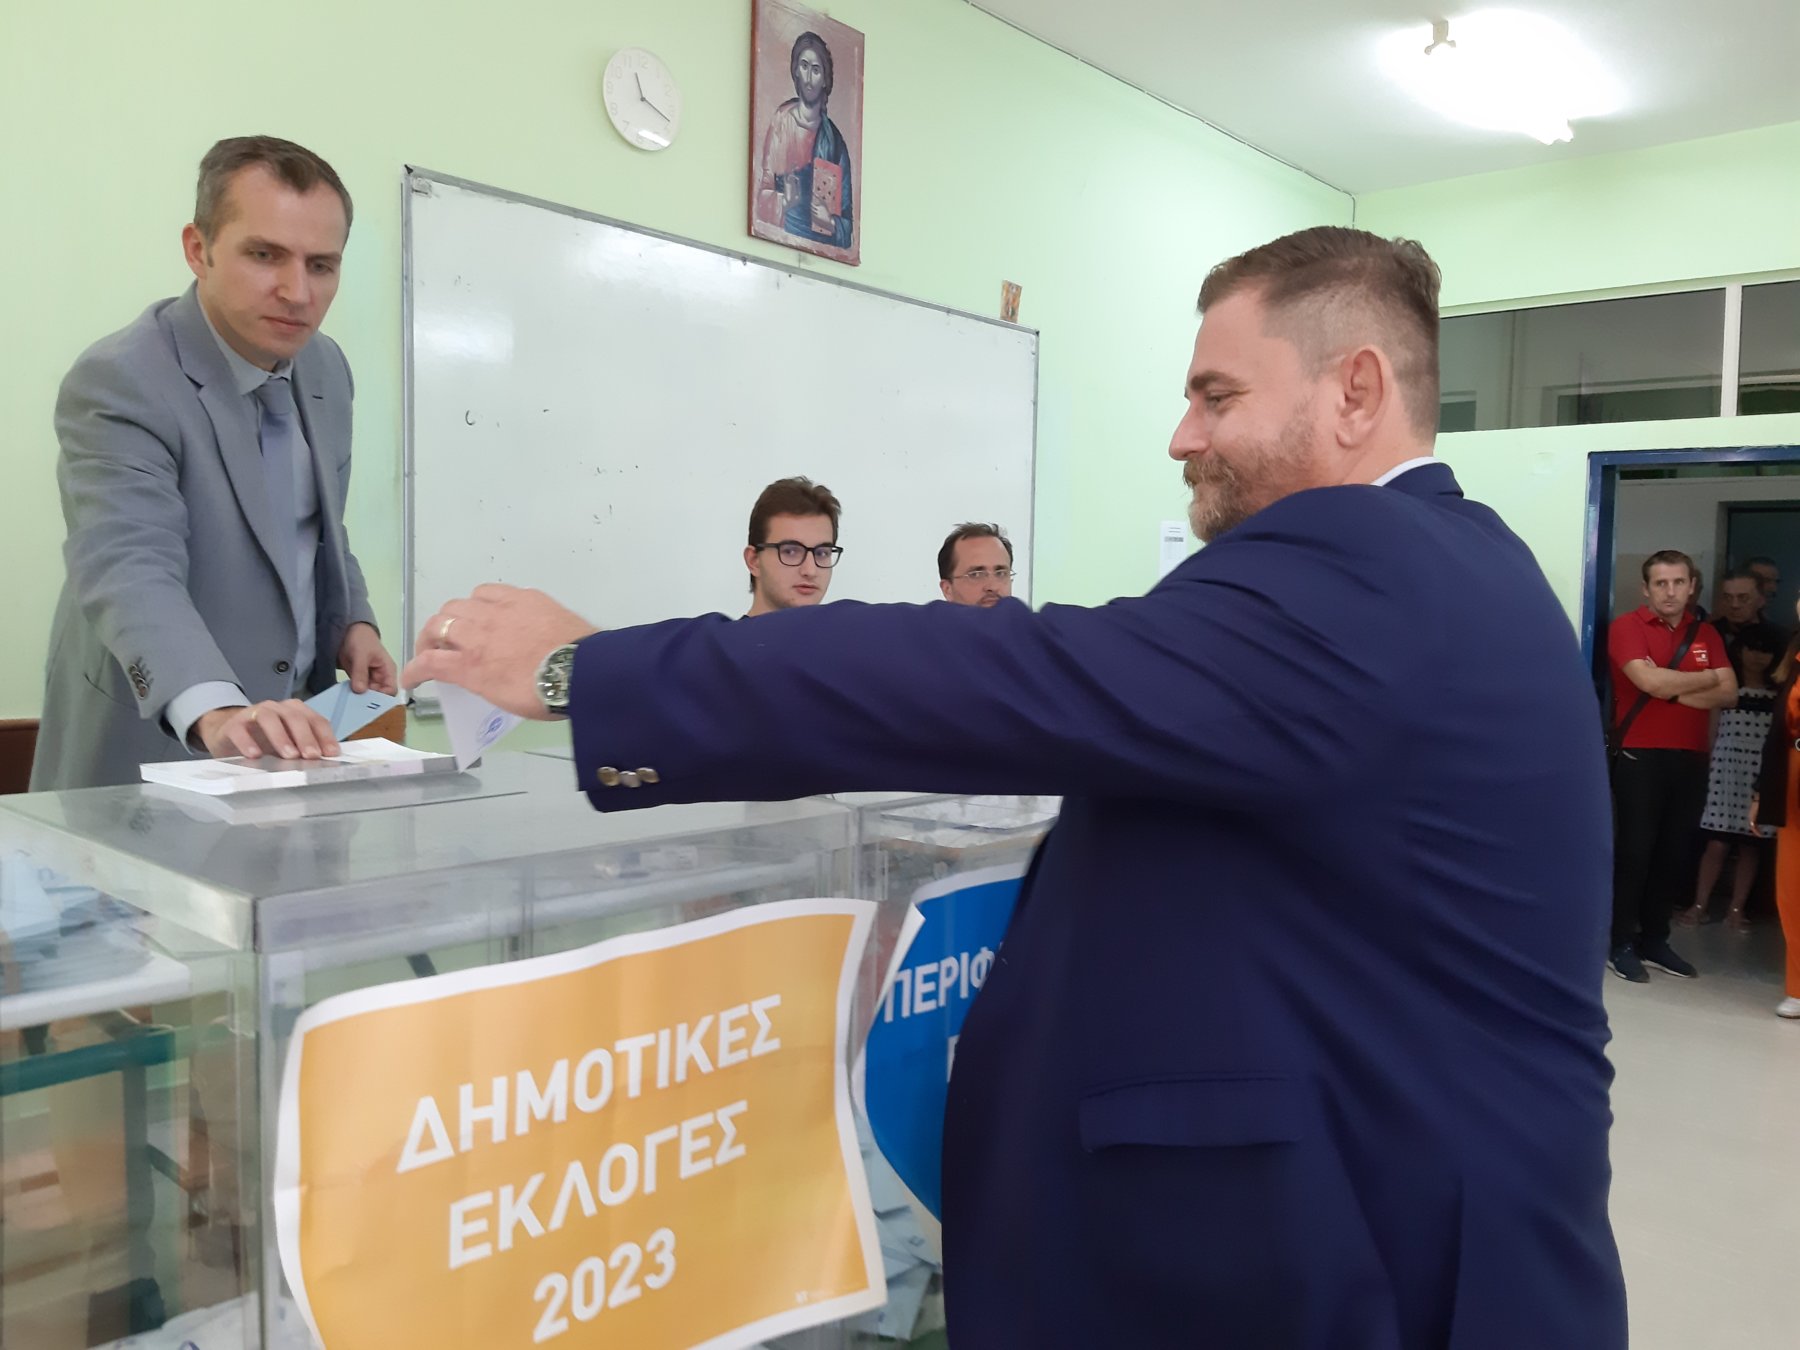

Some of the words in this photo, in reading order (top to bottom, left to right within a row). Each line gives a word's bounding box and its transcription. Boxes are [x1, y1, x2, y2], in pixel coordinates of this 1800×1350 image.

[621, 54, 632, 69] 11
[635, 51, 649, 70] 12
[664, 83, 673, 98] 2
[884, 946, 996, 1024] ΠΕΡΙΦ
[396, 993, 782, 1174] ΔΗΜΟΤΙΚΕΣ
[448, 1100, 748, 1271] ΕΚΛΟΓΕΣ
[533, 1227, 677, 1344] 2023
